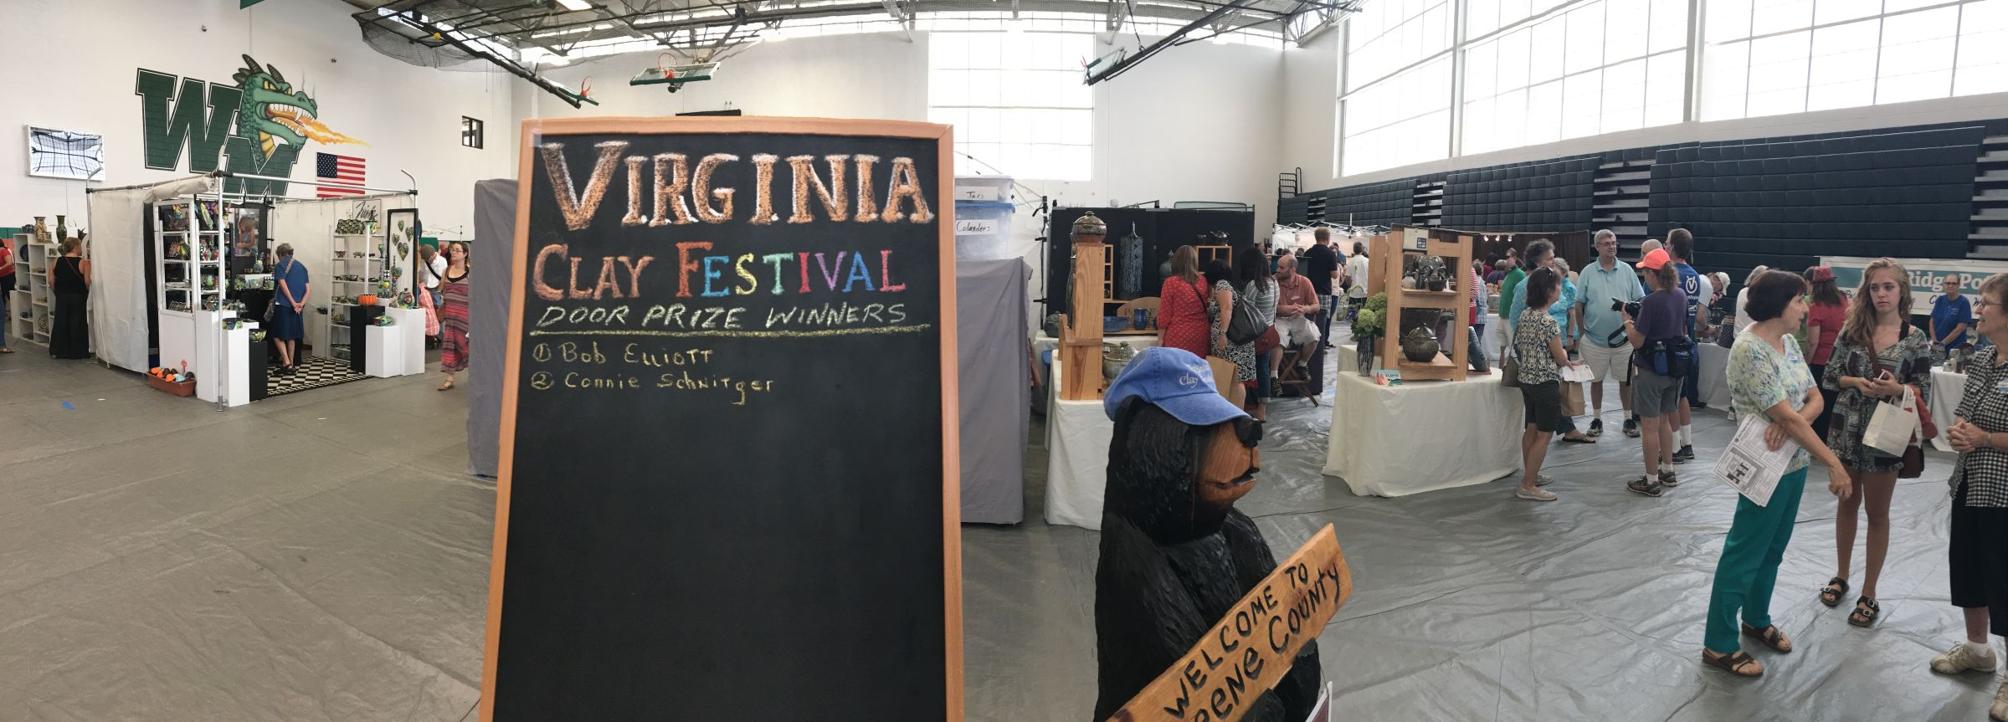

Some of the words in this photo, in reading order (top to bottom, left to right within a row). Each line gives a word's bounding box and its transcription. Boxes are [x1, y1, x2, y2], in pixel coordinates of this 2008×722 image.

[538, 140, 935, 231] VIRGINIA
[533, 243, 656, 299] CLAY
[675, 241, 907, 298] FESTIVAL
[1907, 271, 1944, 292] Ridg
[536, 305, 630, 328] DOOR
[642, 304, 747, 330] PRIZE
[766, 302, 907, 329] WINNERS
[558, 340, 607, 364] Bob
[564, 371, 640, 389] Connie
[1164, 585, 1279, 719] WELCOME
[1284, 562, 1308, 589] TO
